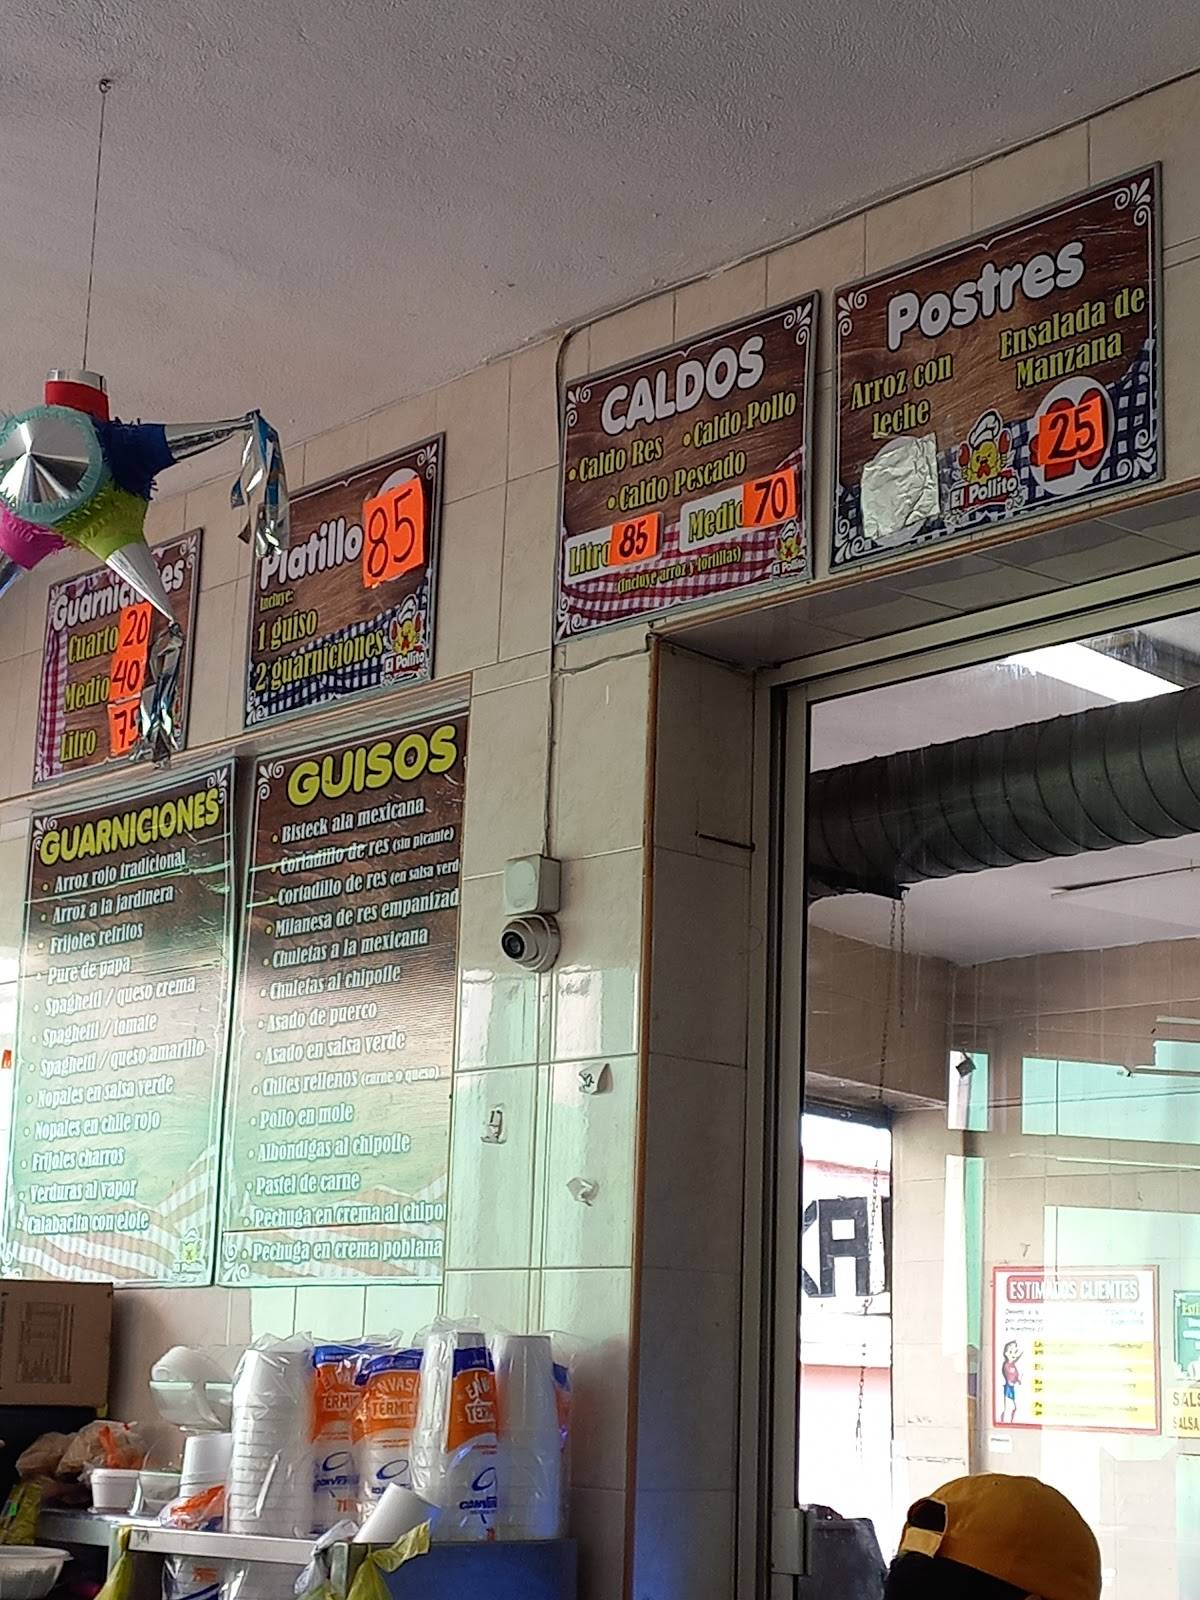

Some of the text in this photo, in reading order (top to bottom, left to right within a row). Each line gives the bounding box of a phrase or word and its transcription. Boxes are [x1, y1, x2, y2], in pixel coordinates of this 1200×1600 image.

[887, 241, 1085, 351] Postres
[1000, 288, 1145, 359] Ensalada de
[1016, 331, 1122, 392] Manzana
[602, 336, 764, 434] CALDOS
[850, 354, 954, 412] Arroz con
[693, 391, 796, 448] Caldo Pollo
[872, 399, 931, 440] Leche
[1048, 405, 1096, 460] 25
[579, 436, 663, 482] Caldo Res
[619, 451, 746, 512] Caldo Pescado
[753, 477, 788, 523] 70
[951, 475, 1018, 507] El Pollito
[367, 489, 415, 578] 85
[619, 523, 648, 558] 85
[260, 517, 364, 590] Platillo
[660, 560, 687, 583] arroz
[688, 561, 695, 577] y
[697, 545, 742, 571] tortillas)
[52, 561, 185, 632] Guarnicies
[68, 625, 120, 664] Cuarto
[123, 610, 148, 647] 20
[257, 609, 318, 651] 1 guiso
[113, 660, 140, 694] 40
[255, 628, 385, 692] 2 guarniciones
[396, 651, 425, 672] Pollito
[64, 675, 110, 714] Medio
[60, 729, 96, 763] Litro
[288, 725, 457, 806] GUISOS
[40, 788, 220, 865] GUARNICIONES
[281, 819, 328, 844] Bisteck
[357, 798, 424, 826] mexicana
[54, 848, 186, 894] Arroz rojo tradicional
[280, 828, 454, 875] Cortadillo de res (sin picante)
[278, 880, 342, 906] Cortadillo
[346, 876, 363, 893] de
[366, 872, 387, 889] res
[390, 869, 407, 886] (en
[409, 864, 434, 882] salsa
[52, 885, 174, 925] Arroz a la jardinera
[274, 915, 332, 939] Milanesa
[336, 909, 352, 927] de
[357, 905, 378, 923] res
[50, 922, 144, 954] Frijoles refritos
[272, 927, 428, 969] Chuletas a la mexicana
[80, 961, 97, 979] de
[99, 956, 131, 980] papa
[270, 965, 401, 1000] Chuletas al chipotle
[44, 976, 196, 1018] Spaghetti / queso crema
[42, 1014, 158, 1048] Spaghetti / tomate
[267, 1002, 377, 1033] Asado de puerco
[40, 1038, 205, 1079] Spaghetti / queso amarillo
[264, 1031, 406, 1065] Asado en salsa verde
[37, 1074, 174, 1109] Nopales en salsa verde
[262, 1065, 440, 1097] Chiles rellenos (carne o queso)
[34, 1110, 161, 1142] Nopales en chile rojo
[259, 1103, 354, 1130] Pollo en mole
[31, 1148, 124, 1173] Frijoles charros
[257, 1132, 411, 1162] Albondigas al chipotle
[30, 1179, 137, 1204] Verduras al vapor
[255, 1173, 361, 1196] Pastel de carne
[27, 1210, 149, 1236] Calabacita con elote
[254, 1205, 312, 1228] Pechuga
[315, 1205, 332, 1223] en
[335, 1205, 381, 1223] crema
[384, 1202, 399, 1222] al
[252, 1238, 443, 1263] Pechuga en crema poblana
[1080, 1279, 1137, 1300] CLIENTES
